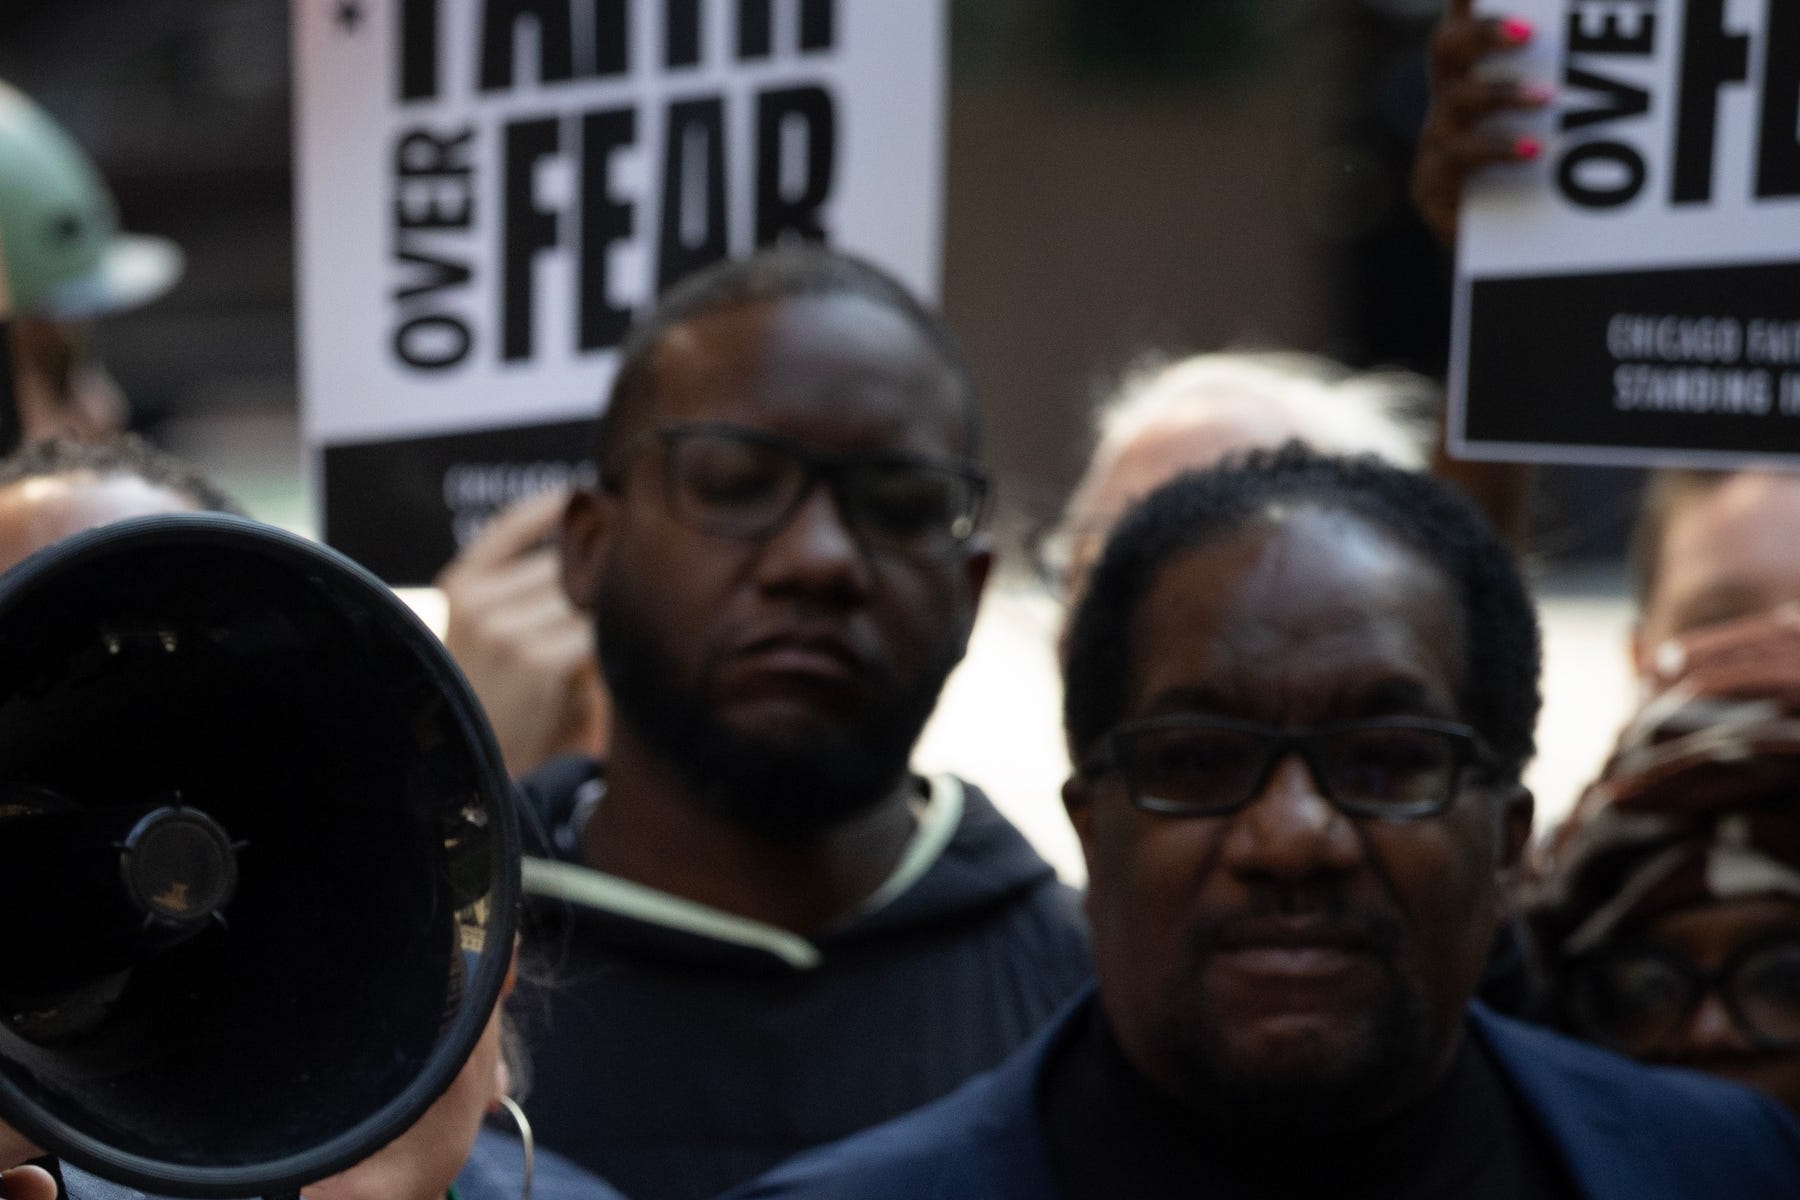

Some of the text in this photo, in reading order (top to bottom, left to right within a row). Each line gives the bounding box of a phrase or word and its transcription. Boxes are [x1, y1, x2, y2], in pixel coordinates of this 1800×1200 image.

[1557, 0, 1657, 209] OVE
[392, 118, 477, 372] OVER
[498, 83, 838, 363] FEAR
[1606, 313, 1743, 364] CHICAGO
[1612, 363, 1773, 416] STANDING
